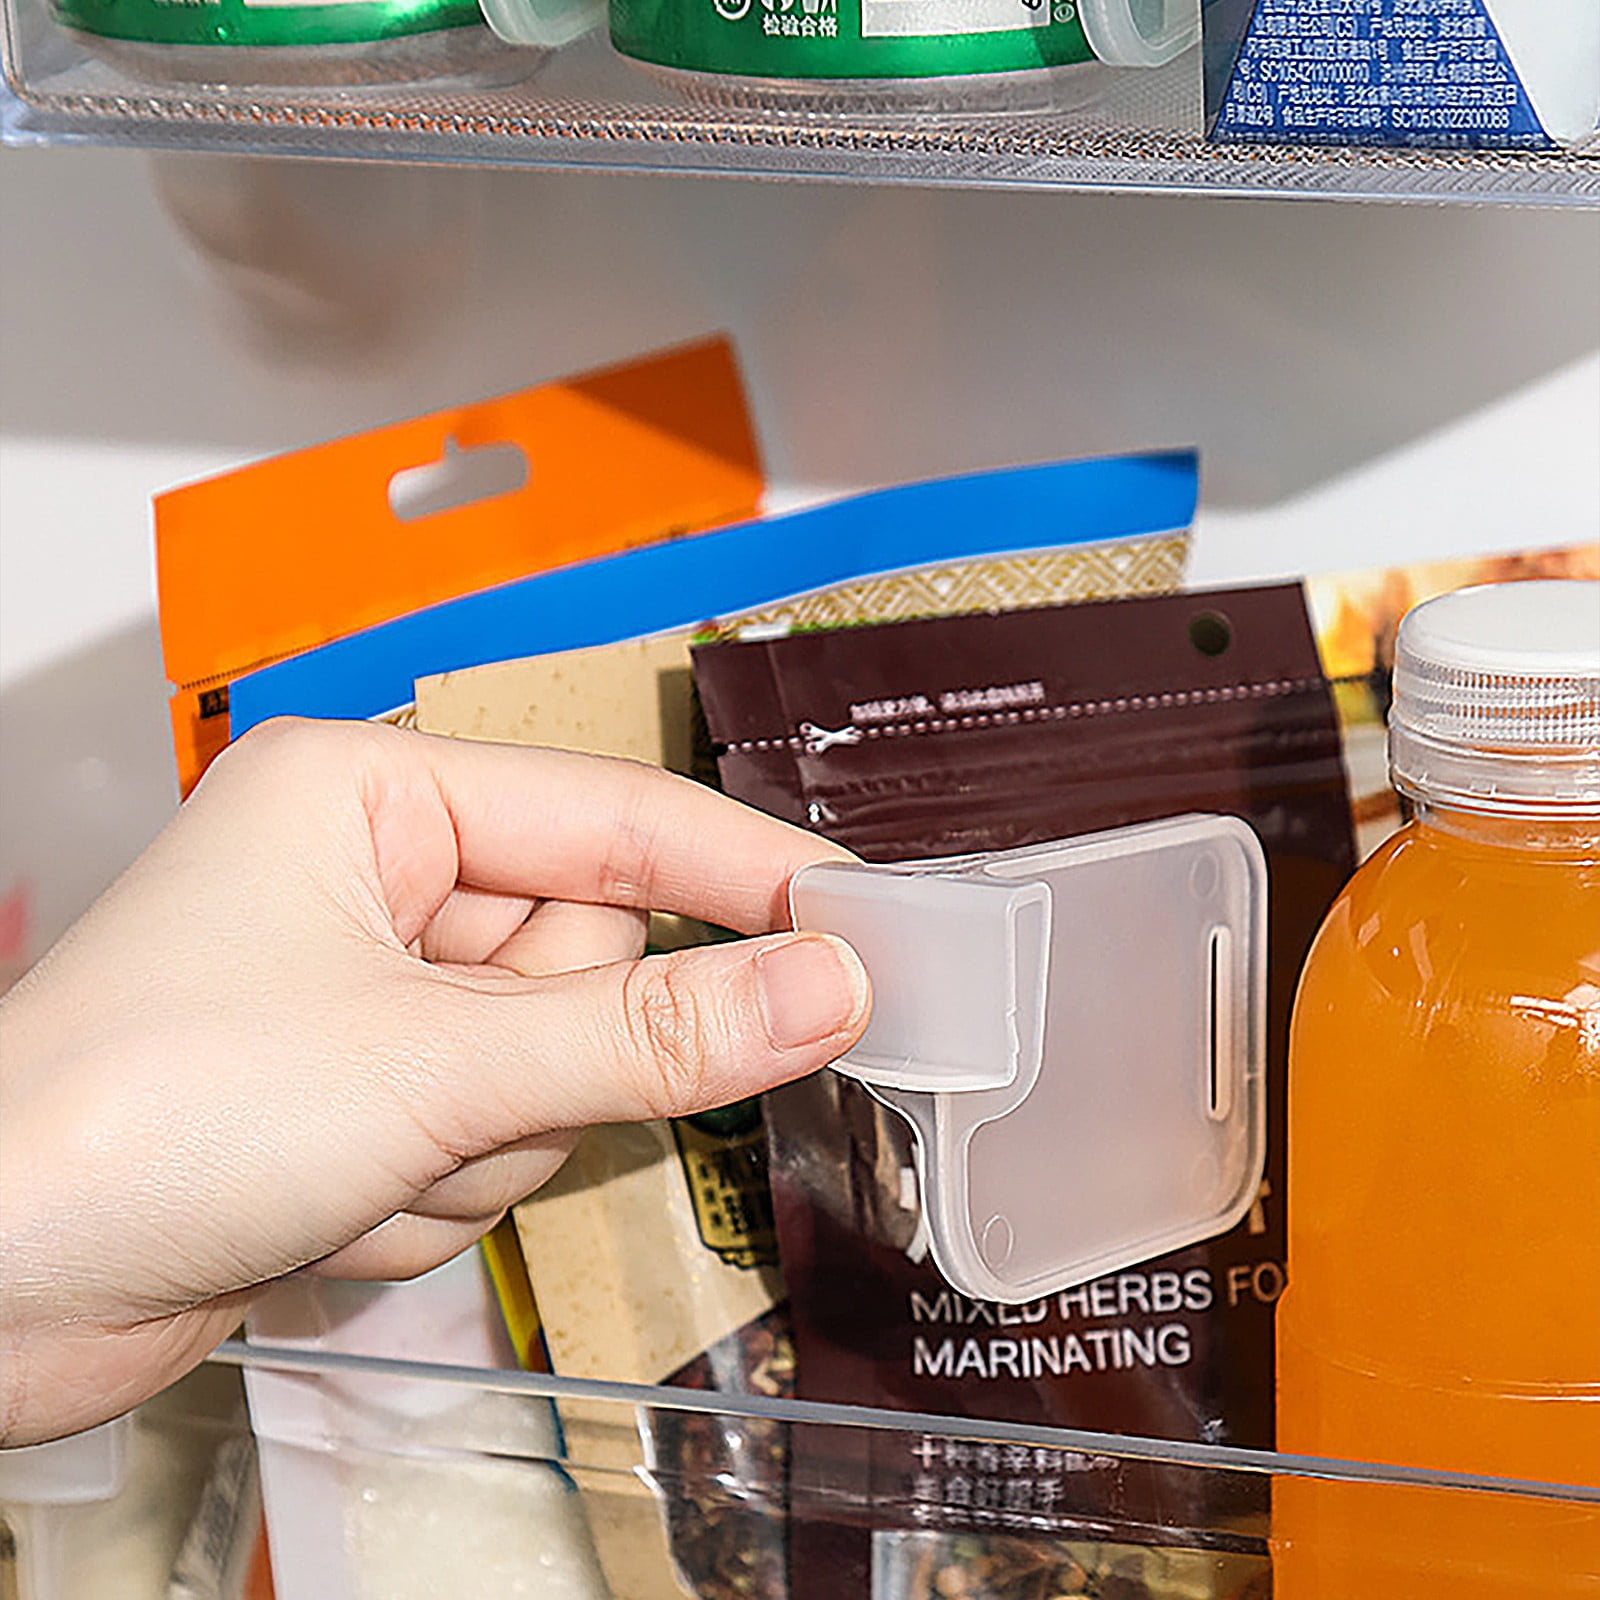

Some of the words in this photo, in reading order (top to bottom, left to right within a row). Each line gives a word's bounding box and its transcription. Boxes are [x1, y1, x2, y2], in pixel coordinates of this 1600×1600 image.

[762, 13, 838, 38] 检验合格
[1057, 1270, 1213, 1321] HERBS
[912, 1323, 1191, 1379] MARINATING
